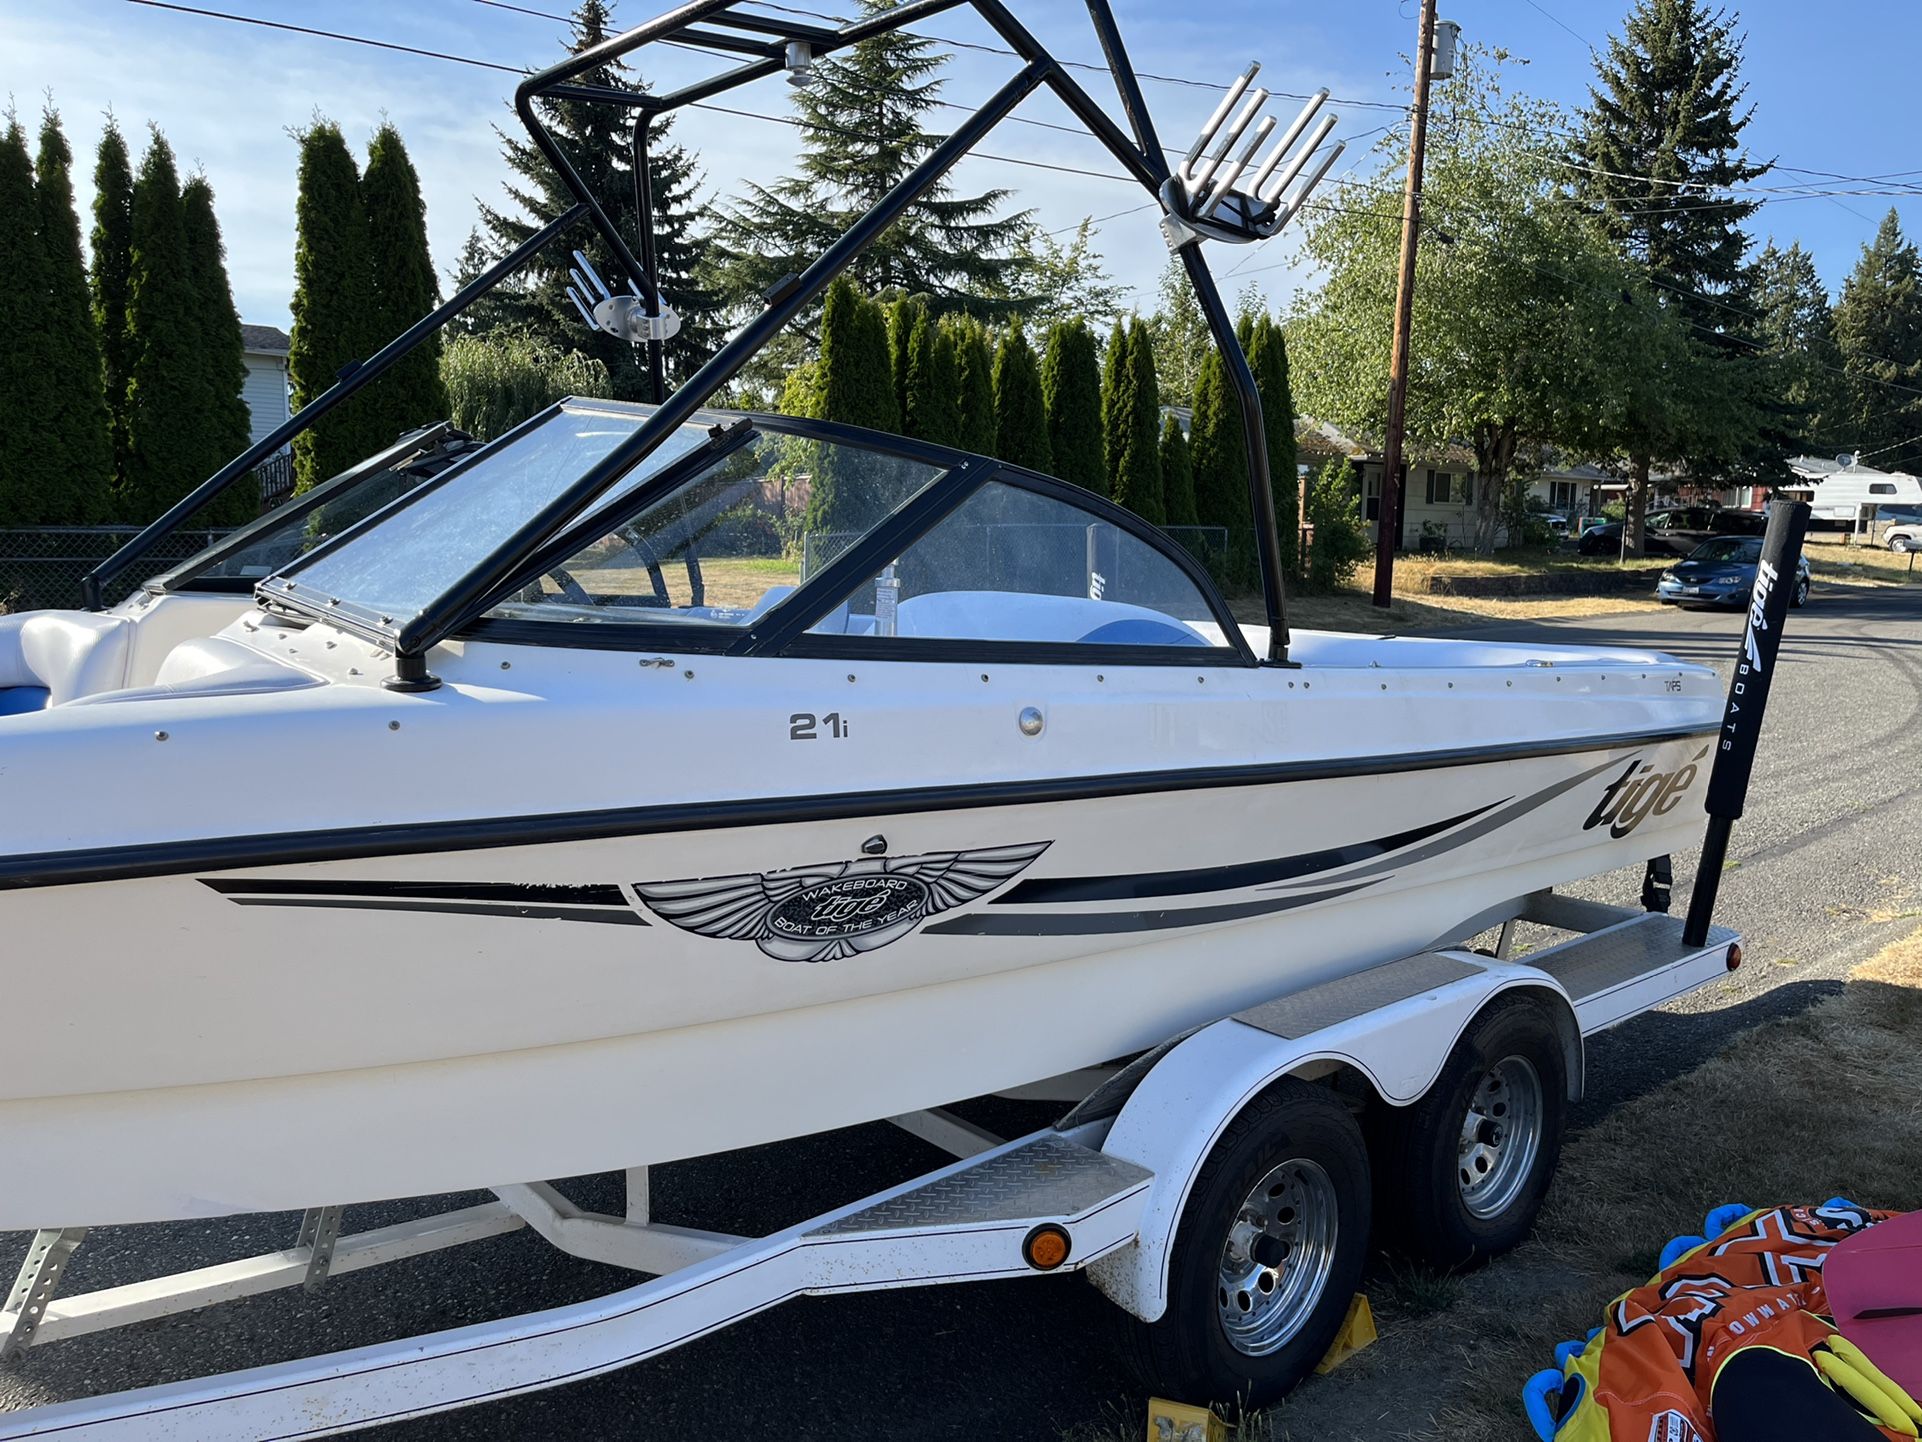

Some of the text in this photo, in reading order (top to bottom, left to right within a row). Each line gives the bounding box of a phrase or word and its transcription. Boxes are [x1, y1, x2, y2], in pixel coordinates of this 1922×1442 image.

[1090, 572, 1106, 600] tig
[1721, 662, 1750, 751] BOATS
[789, 712, 848, 741] 21i
[1582, 743, 1710, 840] tigé
[802, 879, 907, 901] WAKEBOARD
[811, 889, 891, 922] tigé
[774, 899, 918, 935] BOAT OF THE YEAR
